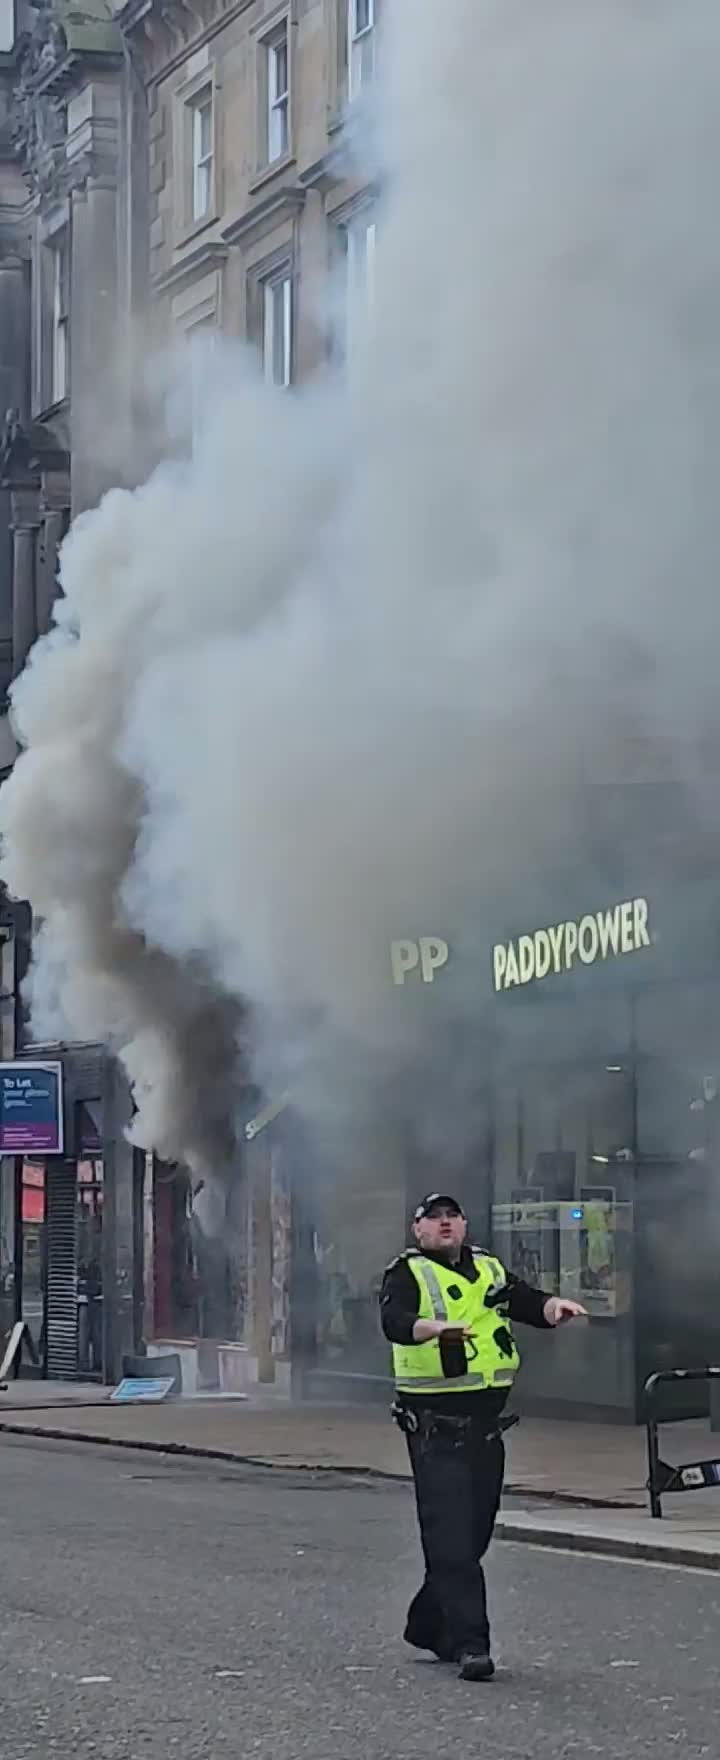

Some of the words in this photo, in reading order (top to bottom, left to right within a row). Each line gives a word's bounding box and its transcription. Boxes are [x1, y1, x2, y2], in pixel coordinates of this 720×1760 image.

[391, 937, 449, 985] PP
[494, 898, 650, 991] PADDYPOWER
[3, 1078, 15, 1088] To
